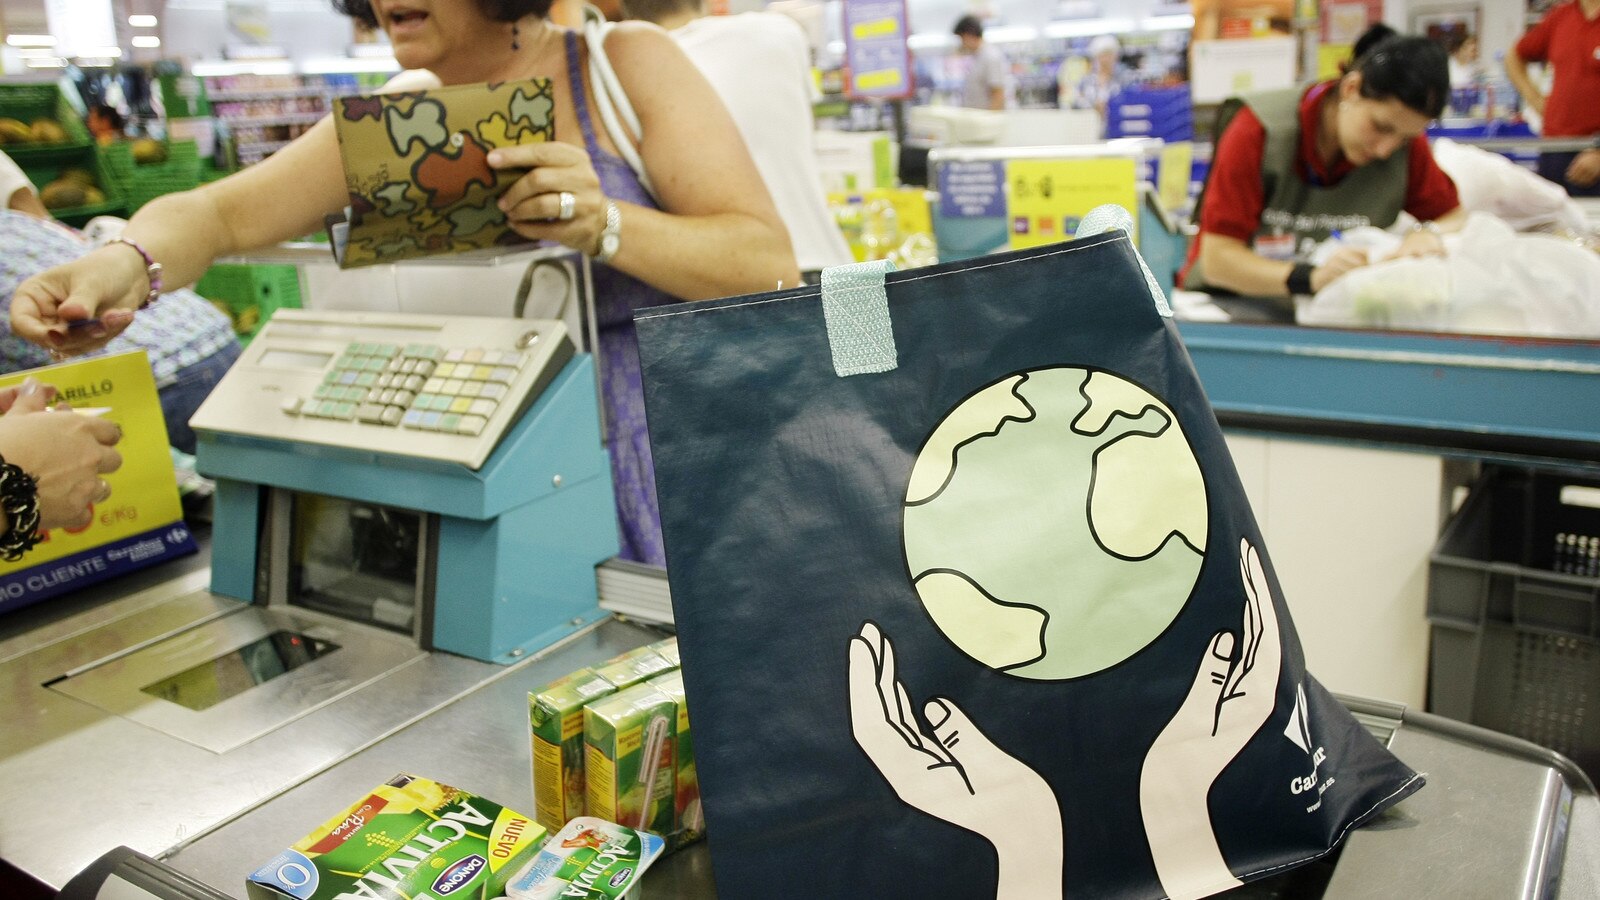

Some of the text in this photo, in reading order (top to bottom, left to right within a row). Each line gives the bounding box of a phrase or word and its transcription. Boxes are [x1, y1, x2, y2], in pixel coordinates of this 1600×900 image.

[47, 379, 113, 404] ARILLO
[26, 555, 107, 592] CLIENTE
[331, 813, 365, 836] Piña
[492, 818, 528, 859] NUEVO
[331, 801, 493, 900] ACTIVIA
[439, 858, 483, 892] DANONE
[560, 844, 630, 897] ACTIVIA
